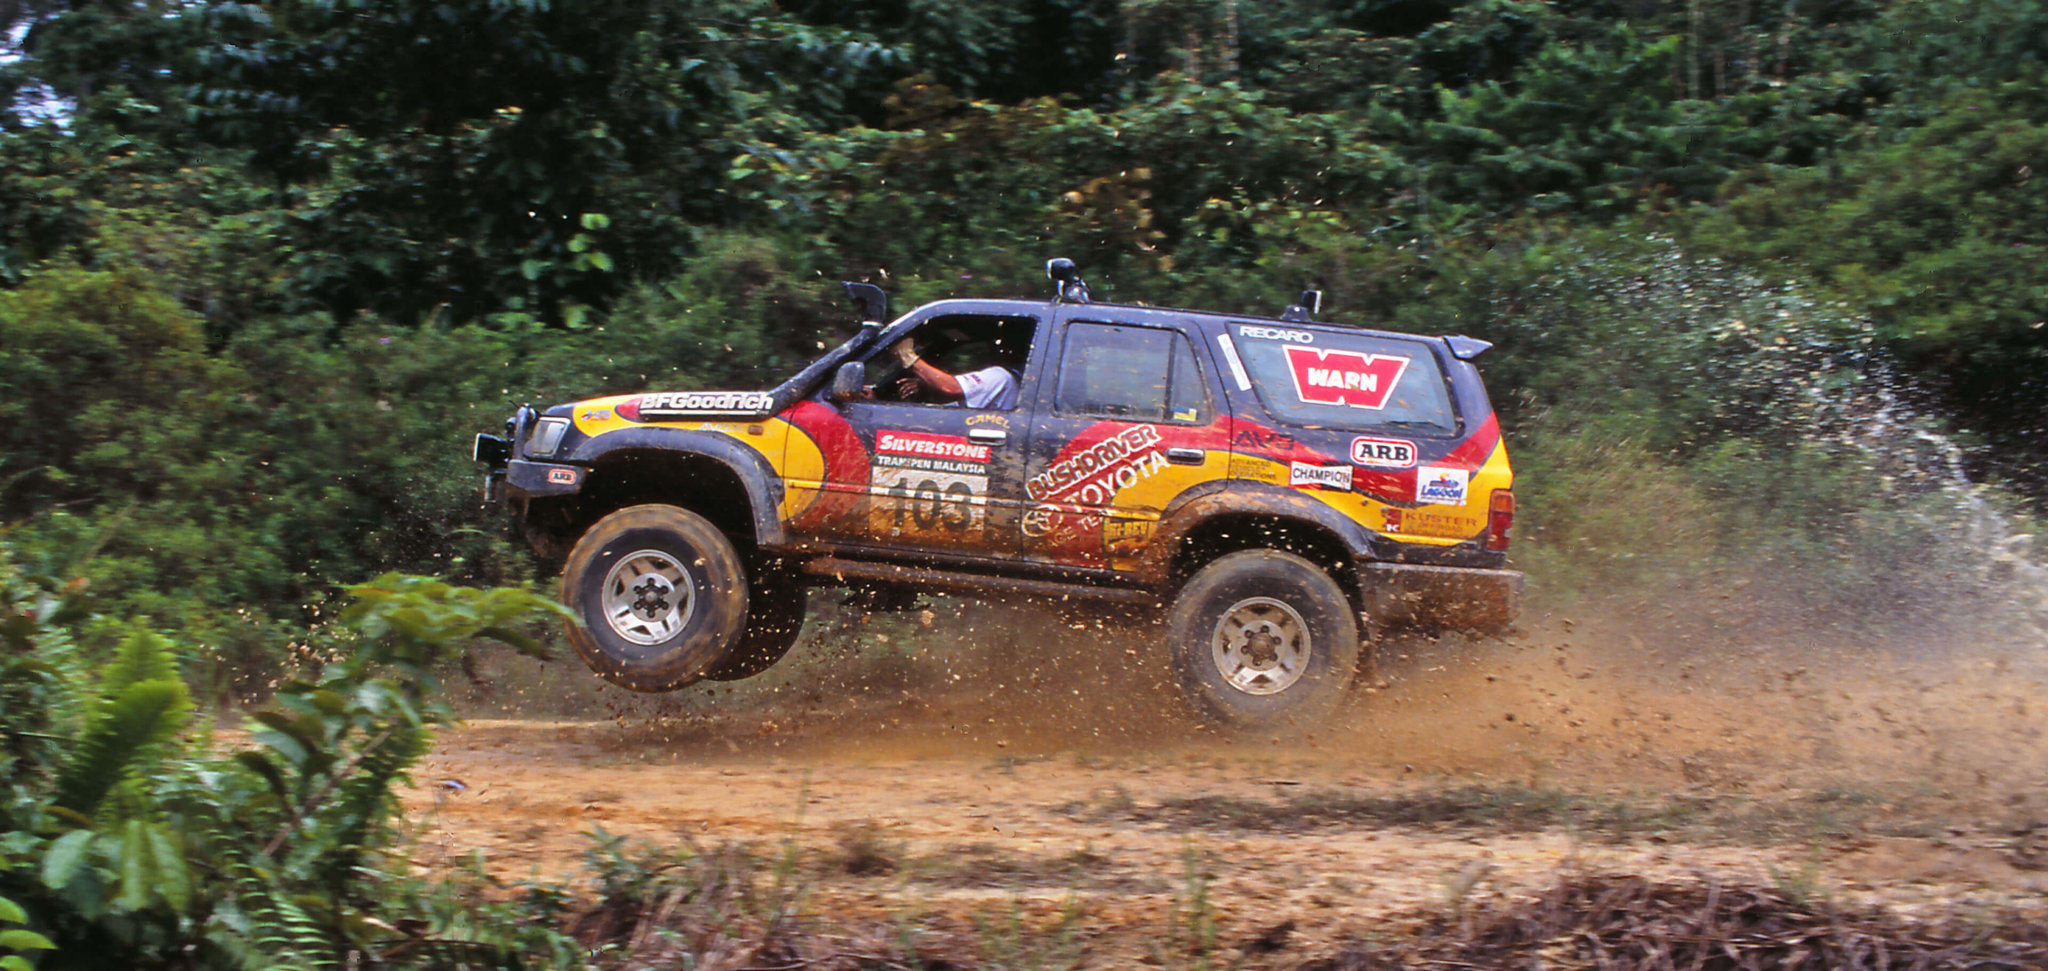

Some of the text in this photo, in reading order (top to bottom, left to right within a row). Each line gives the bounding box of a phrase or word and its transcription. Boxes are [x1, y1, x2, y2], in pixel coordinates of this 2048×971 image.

[1240, 326, 1314, 344] RECARO
[1307, 367, 1377, 393] WARN
[640, 393, 774, 410] BFGoodrich
[965, 414, 1010, 429] CAMEL
[1360, 443, 1409, 460] ARB
[933, 459, 986, 474] MALAYSIA
[1025, 424, 1162, 501] BUSHDRIVER
[552, 471, 572, 481] ARB
[1062, 450, 1171, 514] TOYOTA
[1292, 467, 1351, 483] CHAMPION
[890, 477, 973, 532] 103
[1405, 512, 1478, 527] KUSTER
